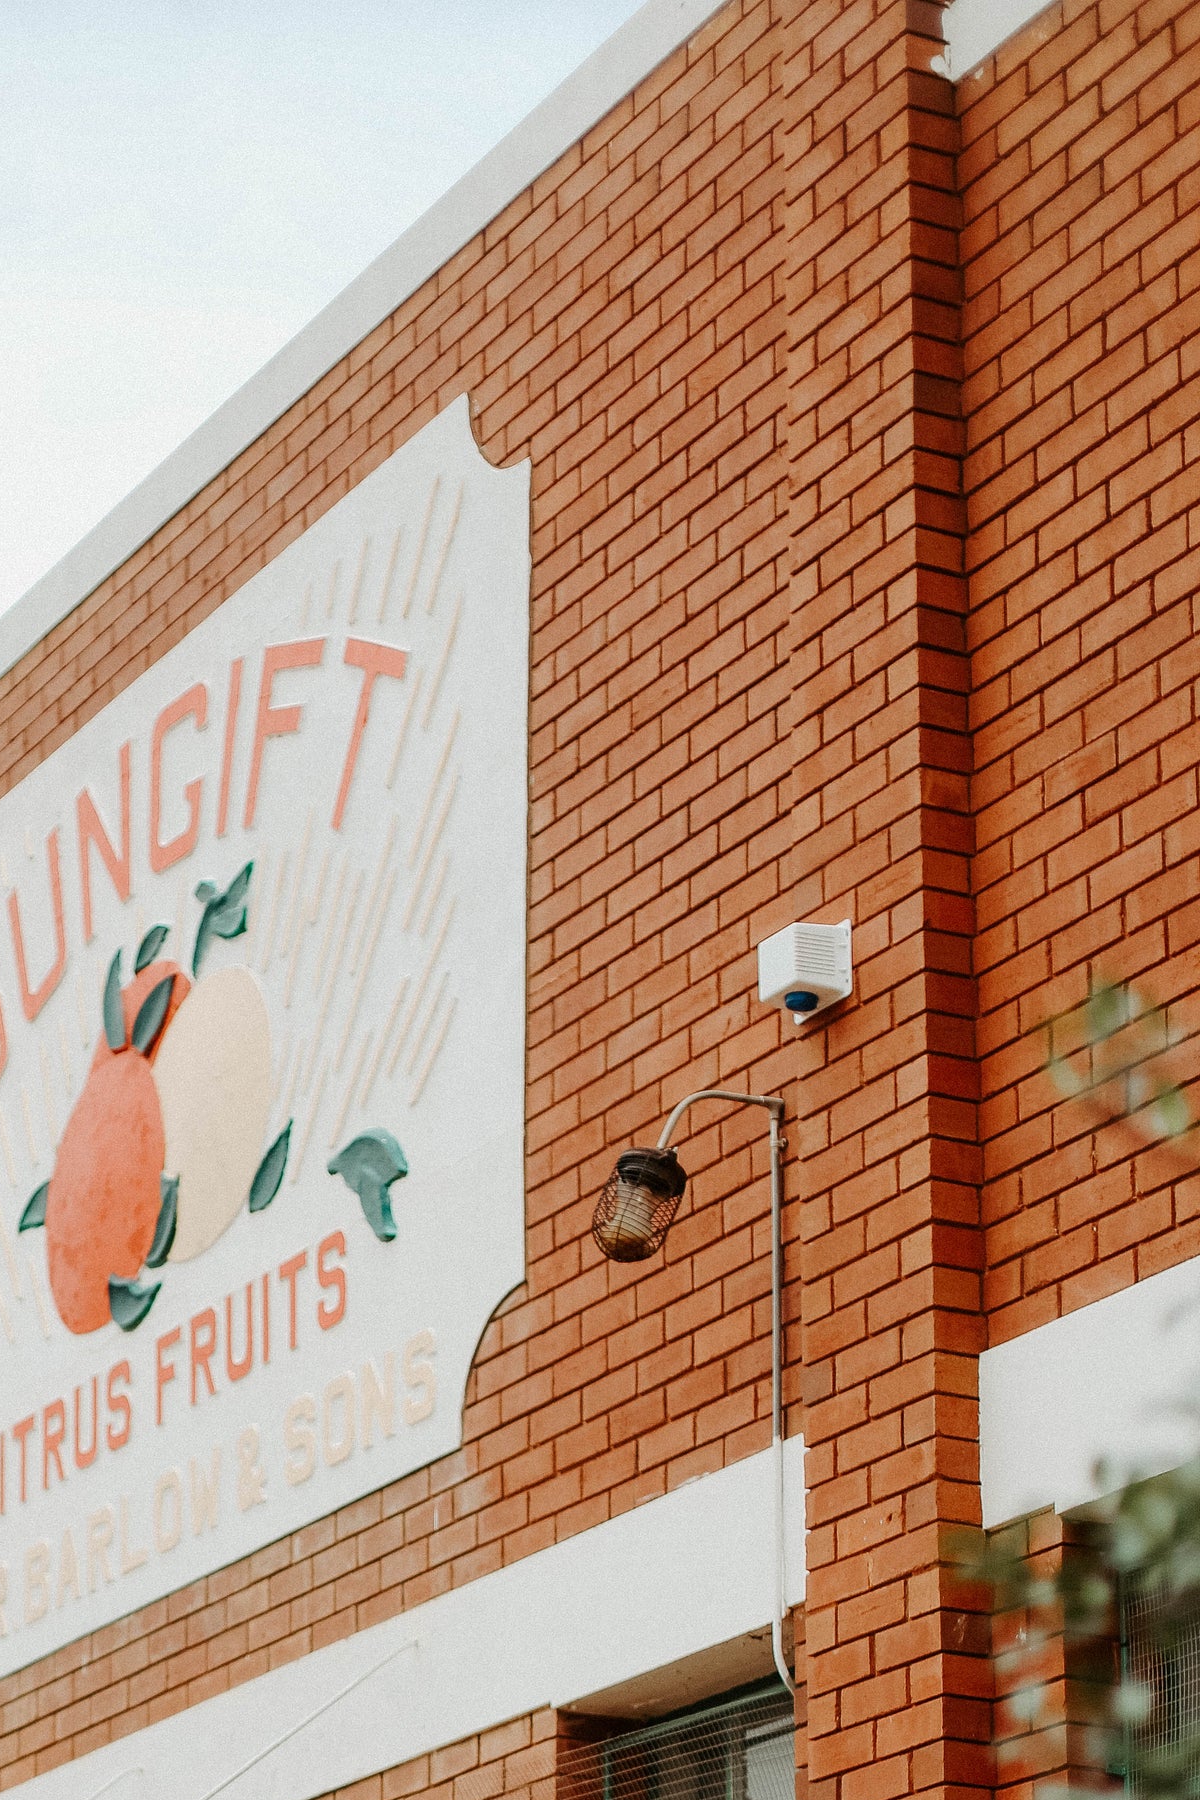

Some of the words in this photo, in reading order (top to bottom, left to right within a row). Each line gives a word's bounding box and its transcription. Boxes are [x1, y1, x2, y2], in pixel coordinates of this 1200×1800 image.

[155, 1230, 348, 1427] FRUITS
[23, 1445, 222, 1625] BARLOW
[236, 1424, 268, 1513] &
[282, 1328, 440, 1487] SONS
